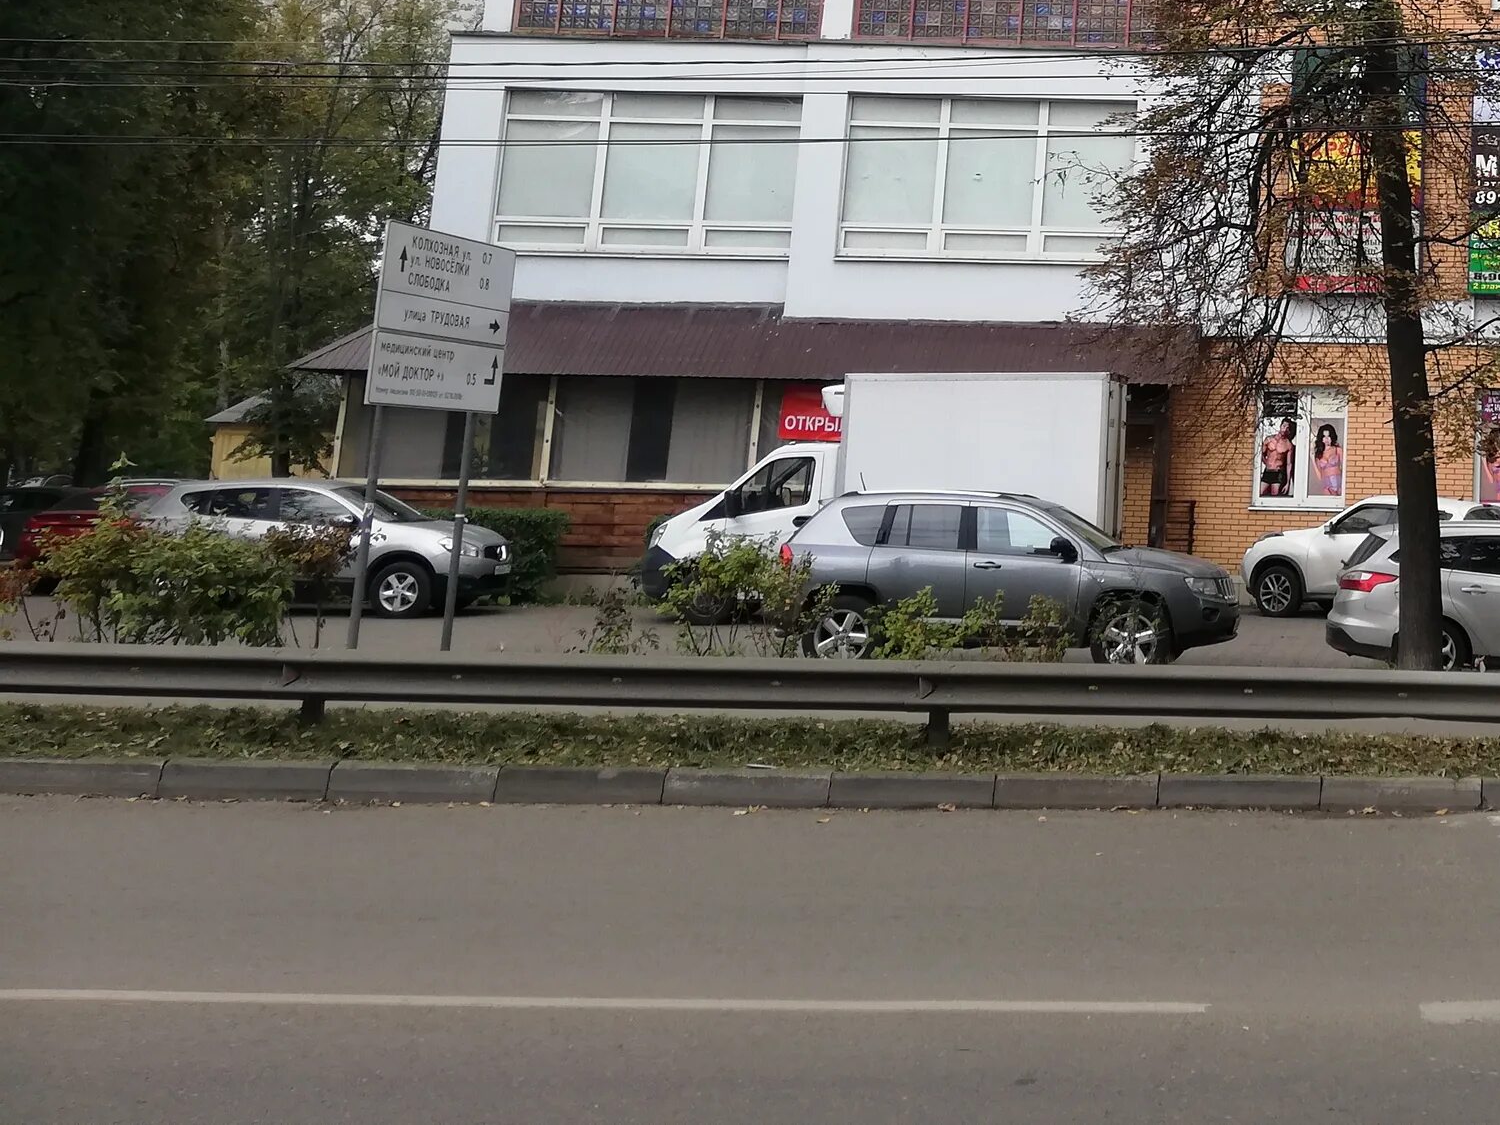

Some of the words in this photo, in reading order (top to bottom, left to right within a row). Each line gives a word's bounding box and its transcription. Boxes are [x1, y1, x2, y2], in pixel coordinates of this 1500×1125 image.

[412, 236, 459, 259] КОЛХОЗНАЯ
[425, 255, 470, 276] НОВОСЁЛКИ
[408, 272, 450, 293] СЛОБОДКА
[404, 309, 427, 323] улица
[431, 310, 470, 330] ТРУДОВАЯ
[381, 341, 431, 357] медицинский
[433, 348, 455, 363] центр
[402, 365, 434, 381] ДОКТОР
